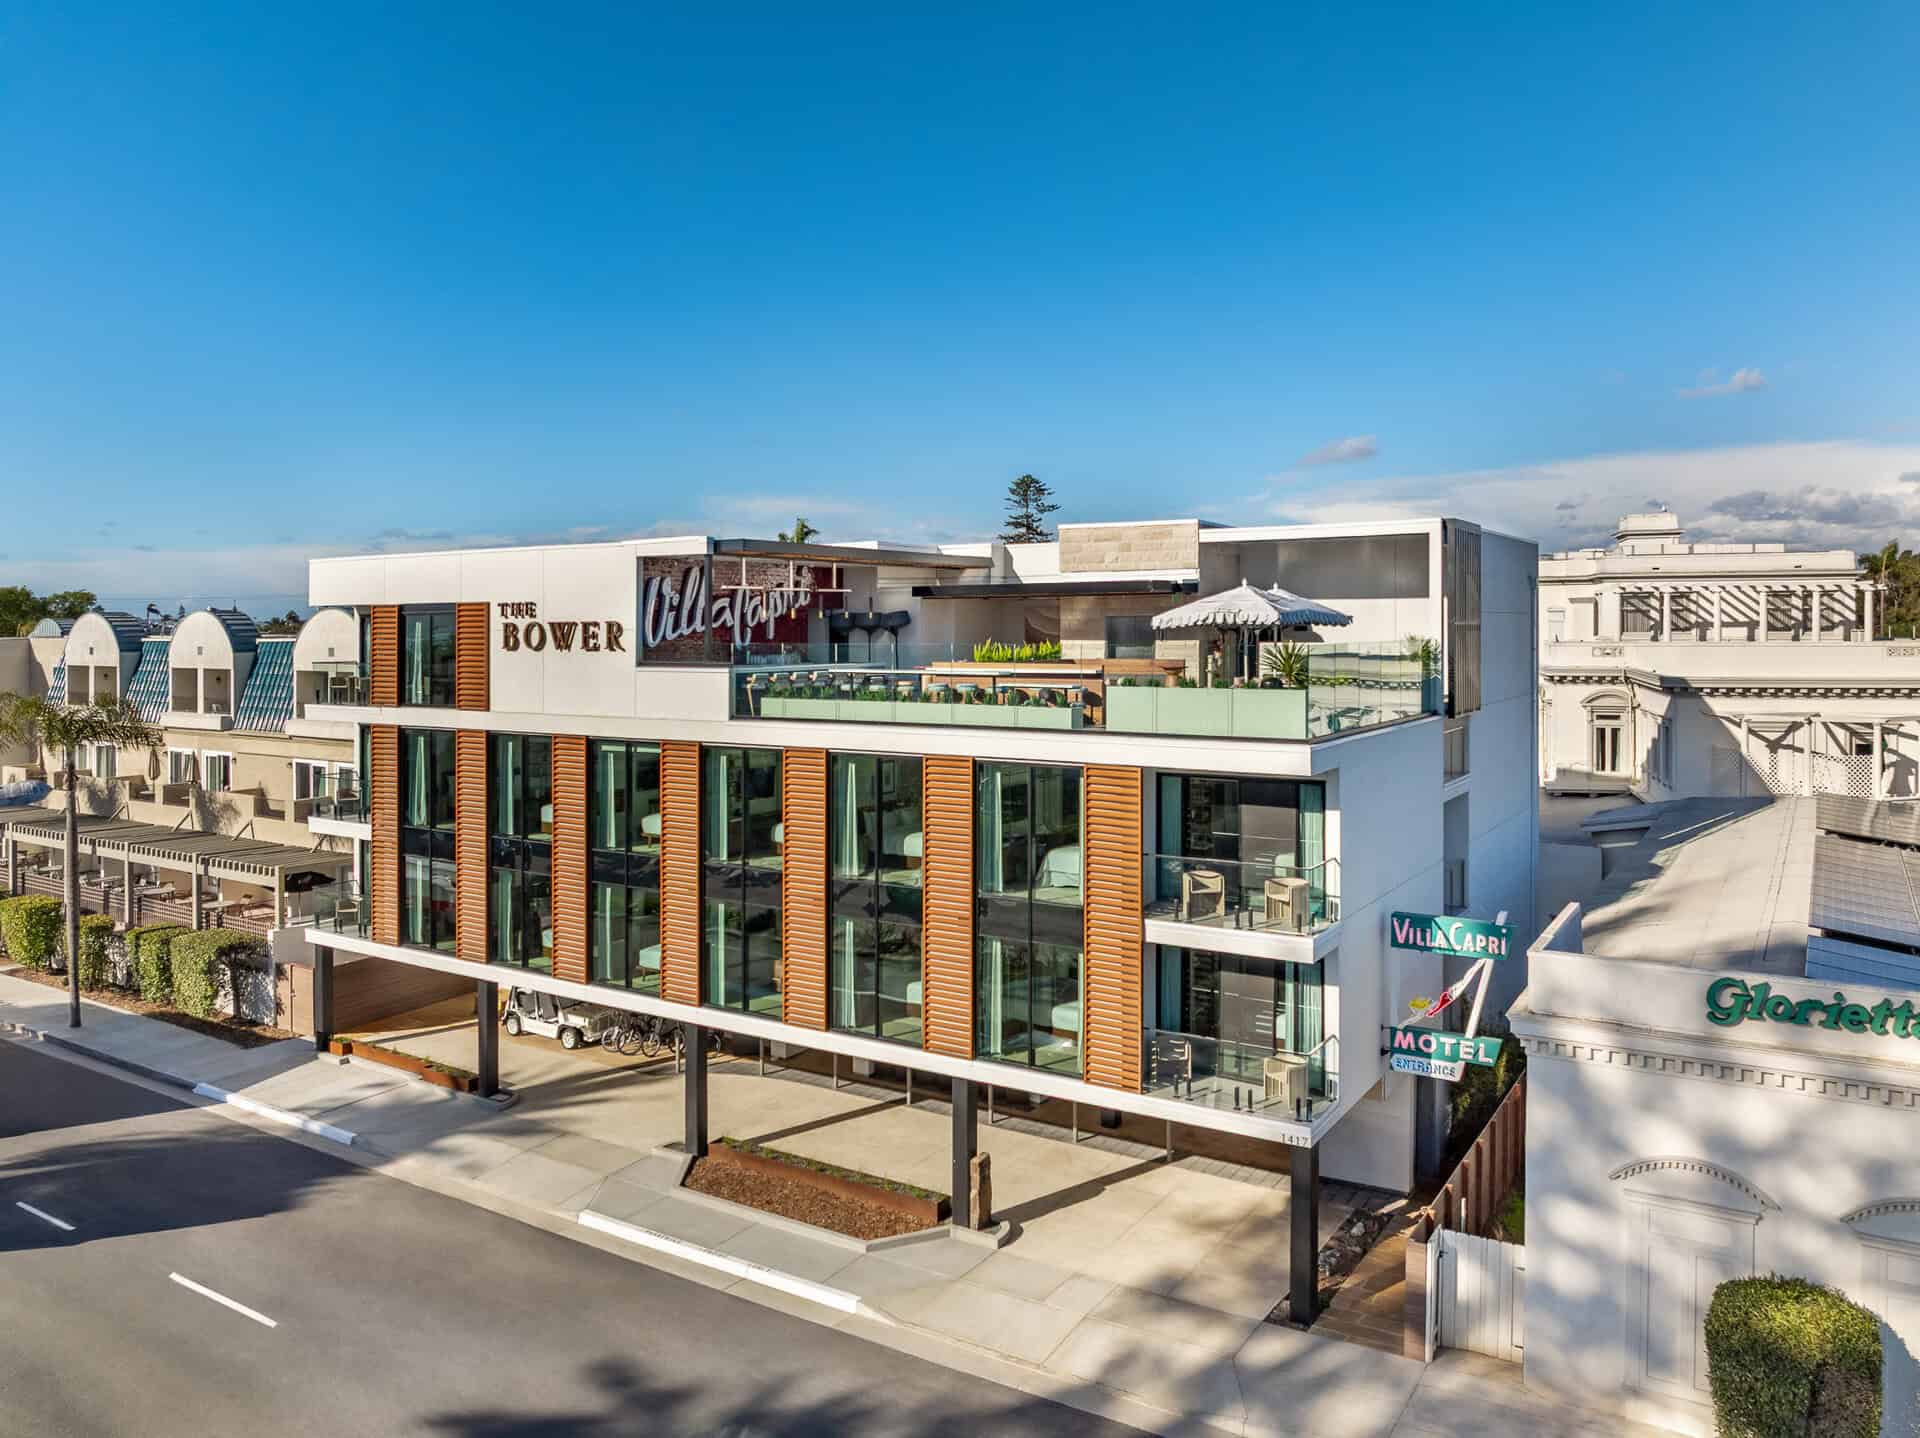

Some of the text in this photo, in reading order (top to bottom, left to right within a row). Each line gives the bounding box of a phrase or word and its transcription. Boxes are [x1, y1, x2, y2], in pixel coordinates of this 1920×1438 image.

[497, 601, 537, 619] THE
[645, 565, 812, 650] Villa Capri
[501, 620, 627, 652] BOWER
[1392, 916, 1448, 949] VILLA
[1393, 1030, 1494, 1064] MOTEL
[1395, 1056, 1457, 1078] ENTRANCE
[1281, 1132, 1309, 1147] 1417
